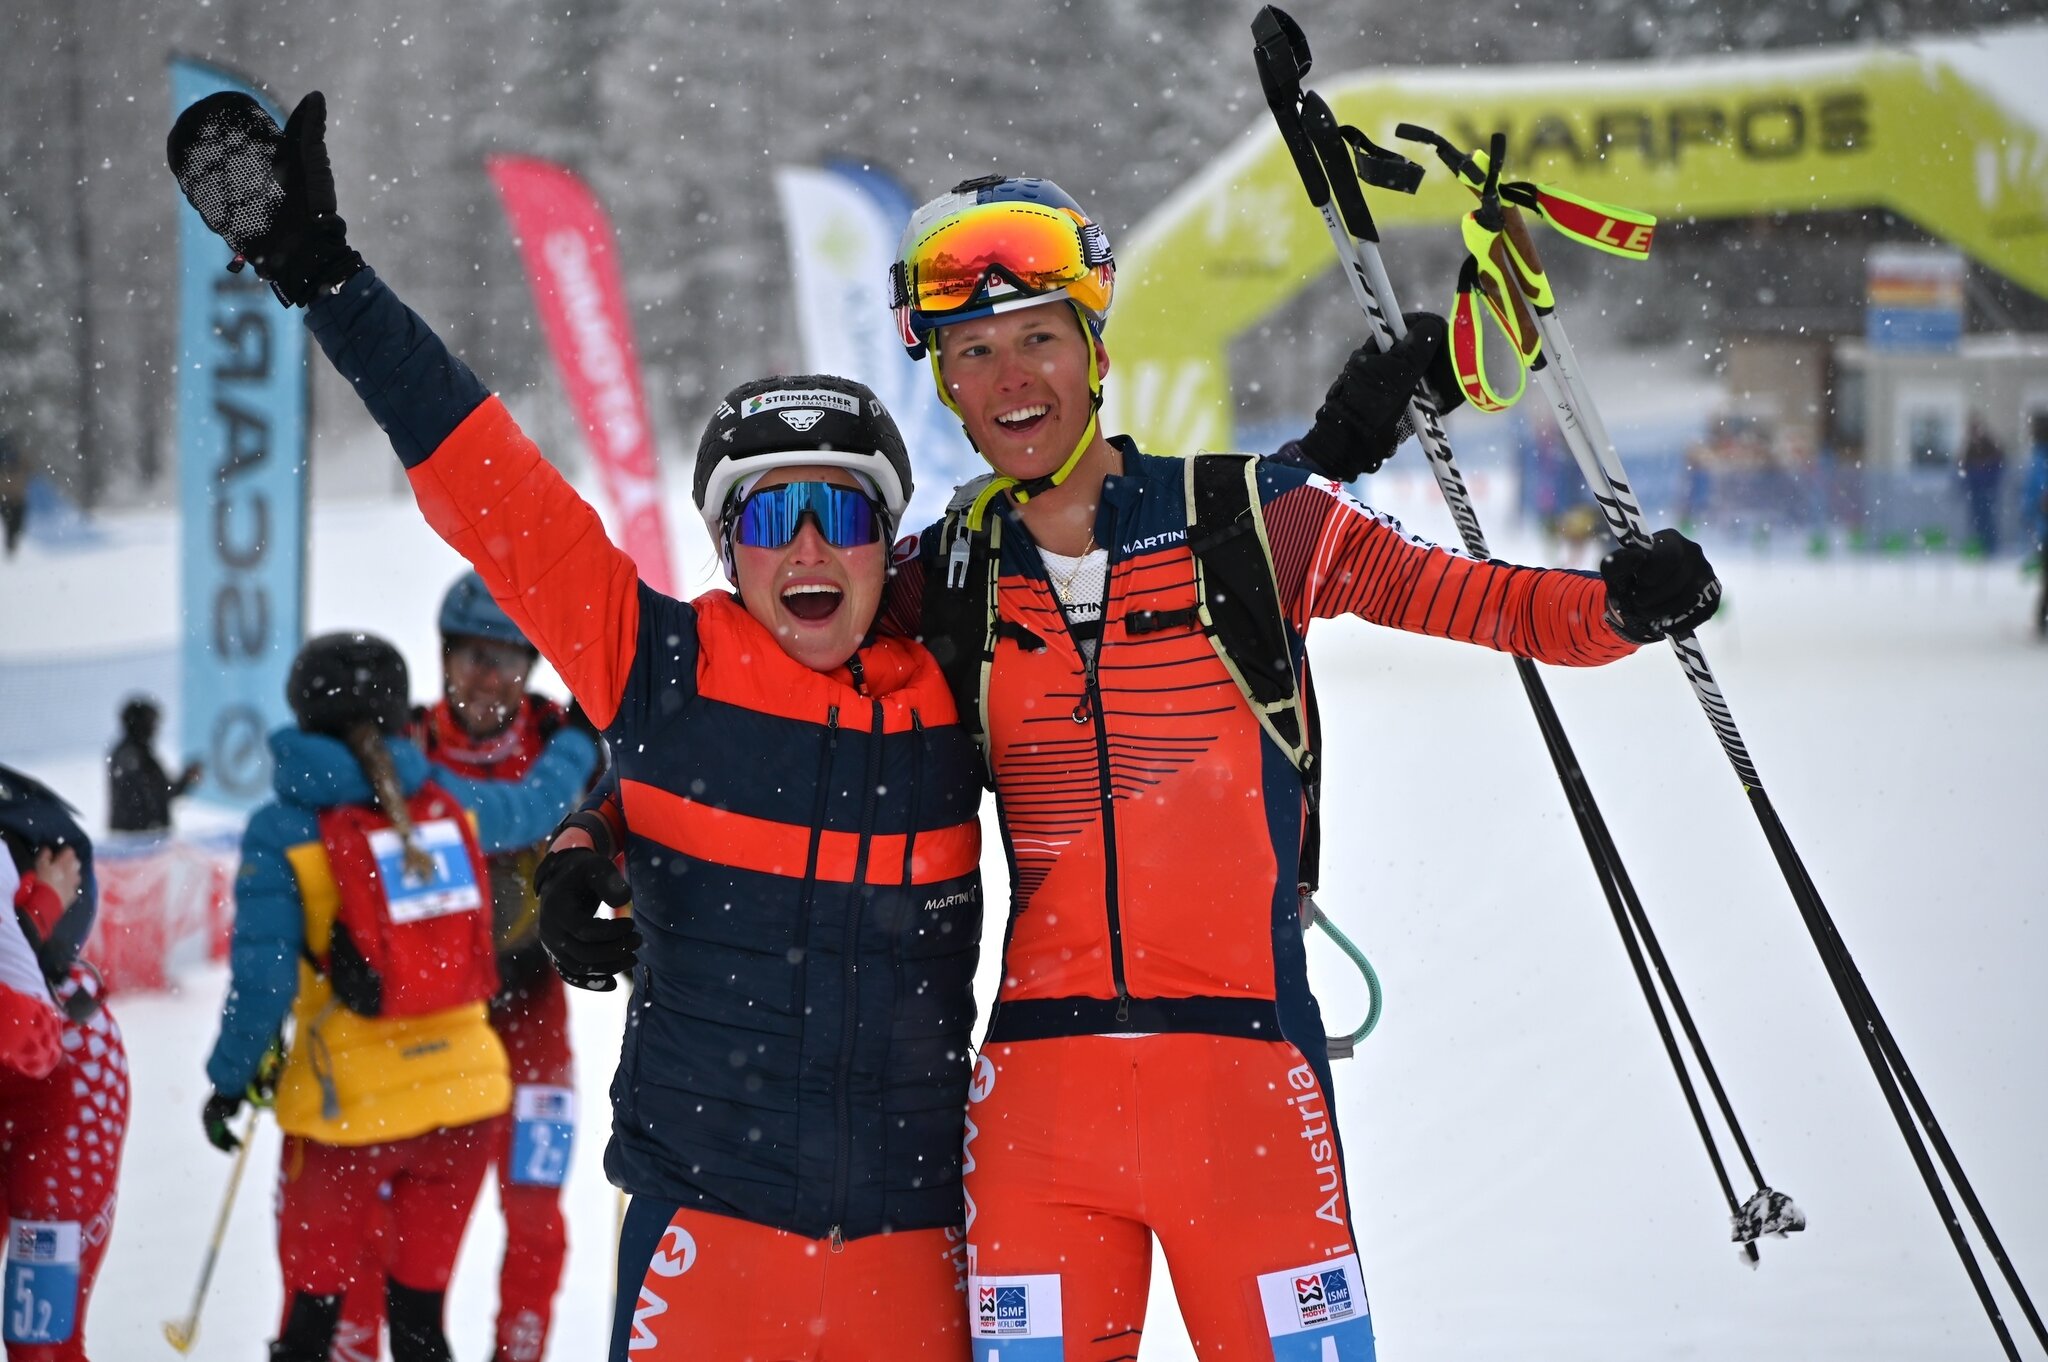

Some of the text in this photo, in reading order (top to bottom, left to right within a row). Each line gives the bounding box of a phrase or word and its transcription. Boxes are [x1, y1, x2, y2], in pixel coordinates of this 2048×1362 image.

[765, 394, 852, 407] STEINBACHER
[924, 891, 969, 911] MARTINI
[1287, 1063, 1344, 1226] Austria
[1327, 1287, 1348, 1302] ISMF
[999, 1306, 1024, 1317] ISMF
[1014, 1320, 1027, 1328] CUP
